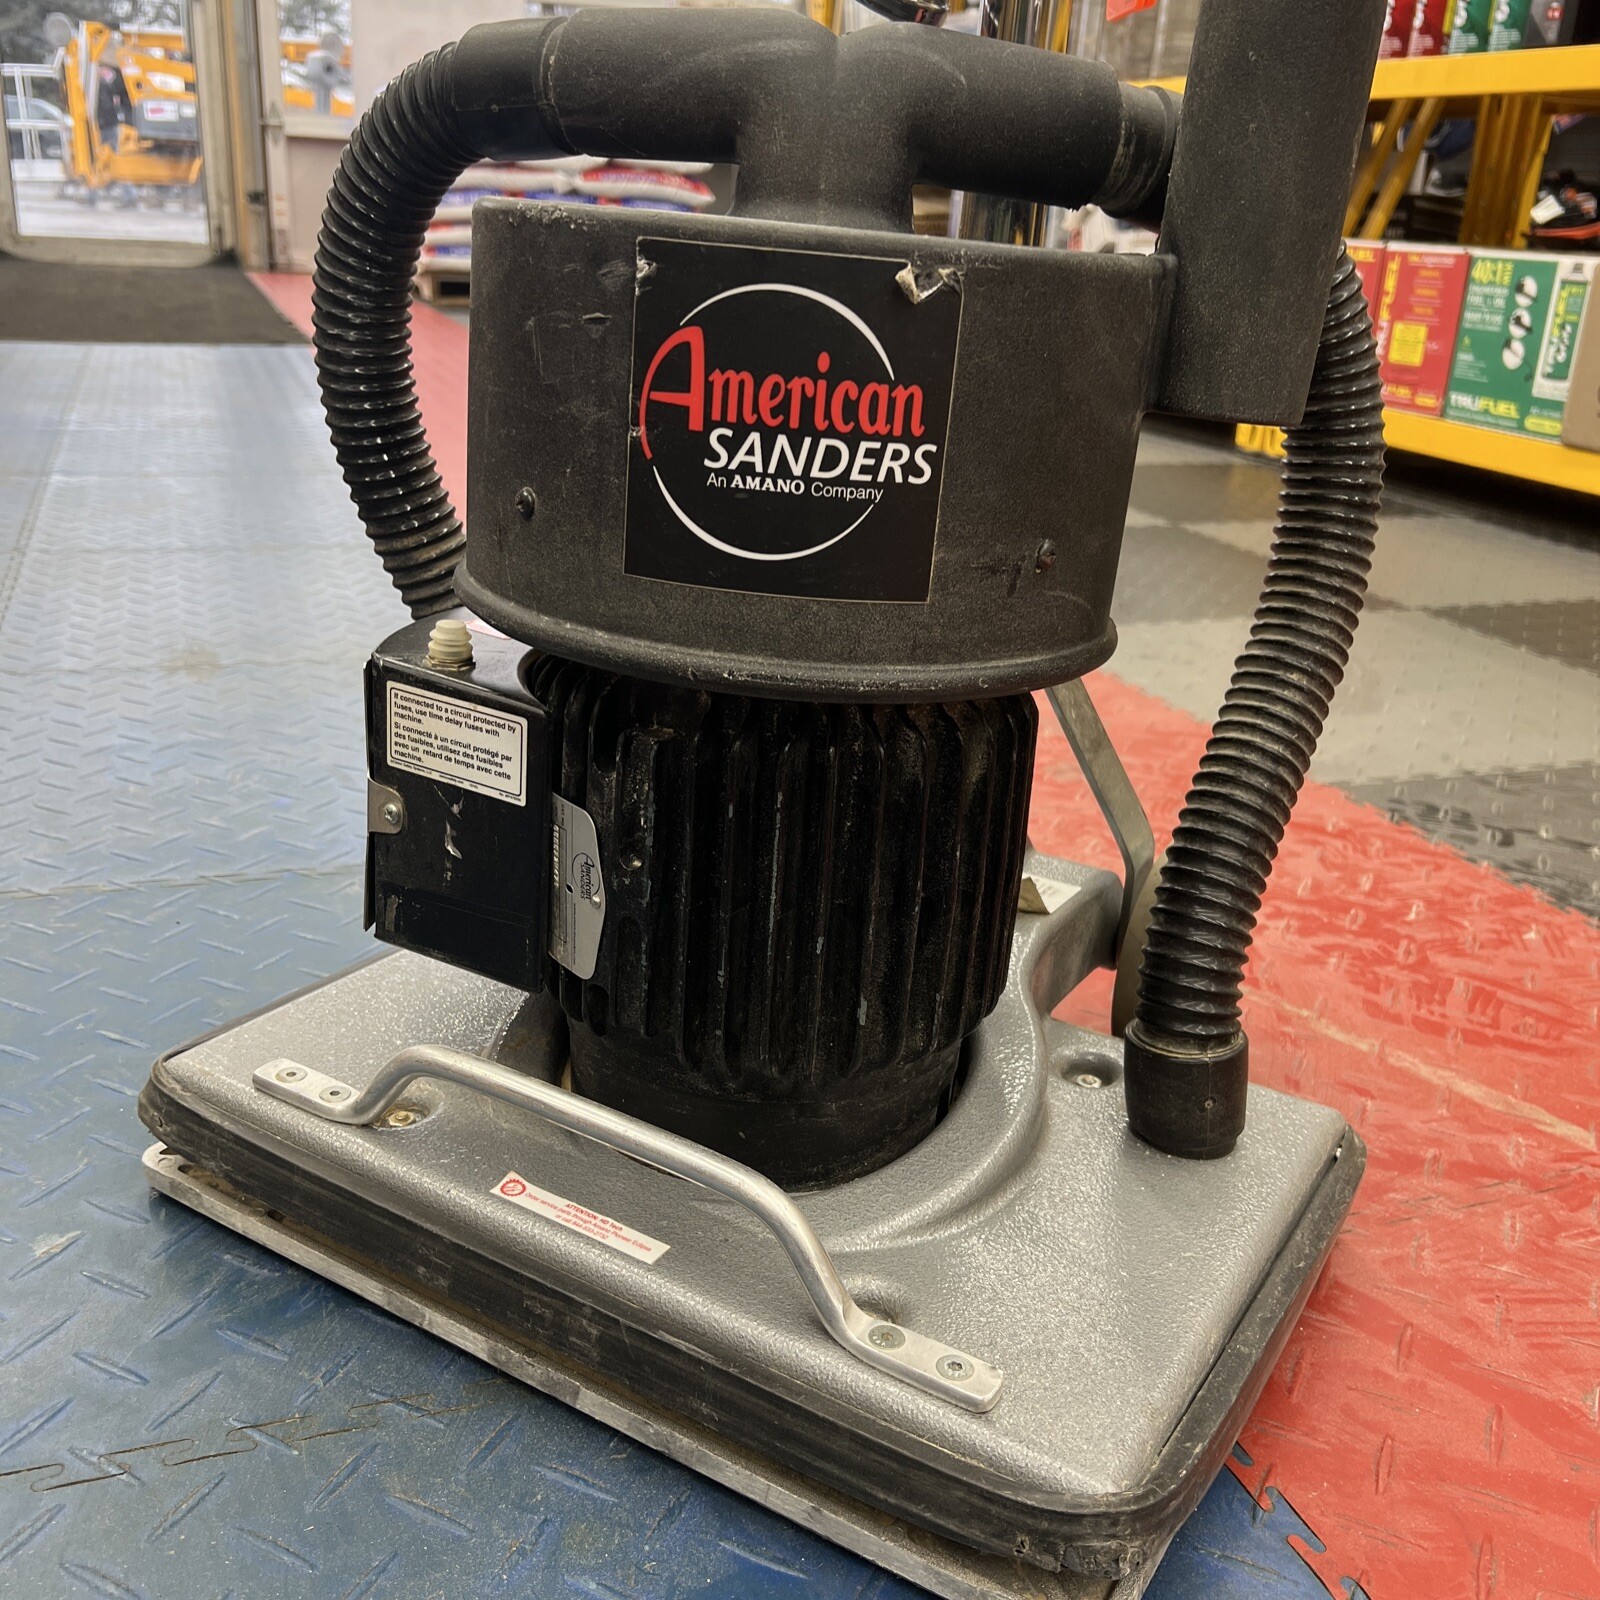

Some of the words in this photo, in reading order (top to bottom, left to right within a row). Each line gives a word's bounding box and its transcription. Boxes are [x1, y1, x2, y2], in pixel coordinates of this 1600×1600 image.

[639, 325, 925, 440] American
[1449, 390, 1520, 419] TRUFUEL
[704, 428, 937, 485] SANDERS
[707, 472, 727, 488] An
[730, 474, 806, 495] AMANO
[811, 482, 884, 504] Company
[394, 710, 424, 726] machine.
[394, 701, 414, 714] fuses,
[415, 708, 428, 717] use
[428, 710, 444, 722] time
[444, 715, 464, 728] delay
[464, 722, 484, 733] fuses
[485, 726, 500, 738] with
[400, 694, 434, 710] connected
[436, 704, 443, 712] to
[450, 707, 472, 720] circuit
[473, 715, 506, 730] protected
[508, 722, 516, 734] by
[394, 722, 401, 730] Si
[402, 725, 432, 739] connecté
[434, 732, 438, 740] à
[450, 738, 472, 751] circuit
[473, 745, 499, 759] protégé
[500, 752, 512, 762] par
[394, 731, 406, 740] des
[408, 734, 436, 750] fusibles,
[436, 744, 460, 756] utilisez
[462, 750, 474, 760] des
[476, 754, 504, 769] fusibles
[394, 750, 424, 764] machine.
[394, 742, 410, 750] avec
[422, 748, 442, 760] retard
[444, 754, 453, 763] de
[454, 758, 475, 770] temps
[476, 766, 492, 775] avec
[494, 770, 512, 780] cette
[584, 854, 594, 900] American
[524, 1192, 540, 1202] Order
[540, 1198, 558, 1210] service
[558, 1206, 572, 1218] parts
[572, 1212, 592, 1226] through
[592, 1220, 610, 1233] Amano
[611, 1229, 632, 1244] Pioneer
[632, 1239, 652, 1252] Eclipse
[561, 1214, 572, 1224] call
[565, 1203, 598, 1221] ATTENTION:
[600, 1217, 610, 1226] HD
[610, 1221, 624, 1232] Tech
